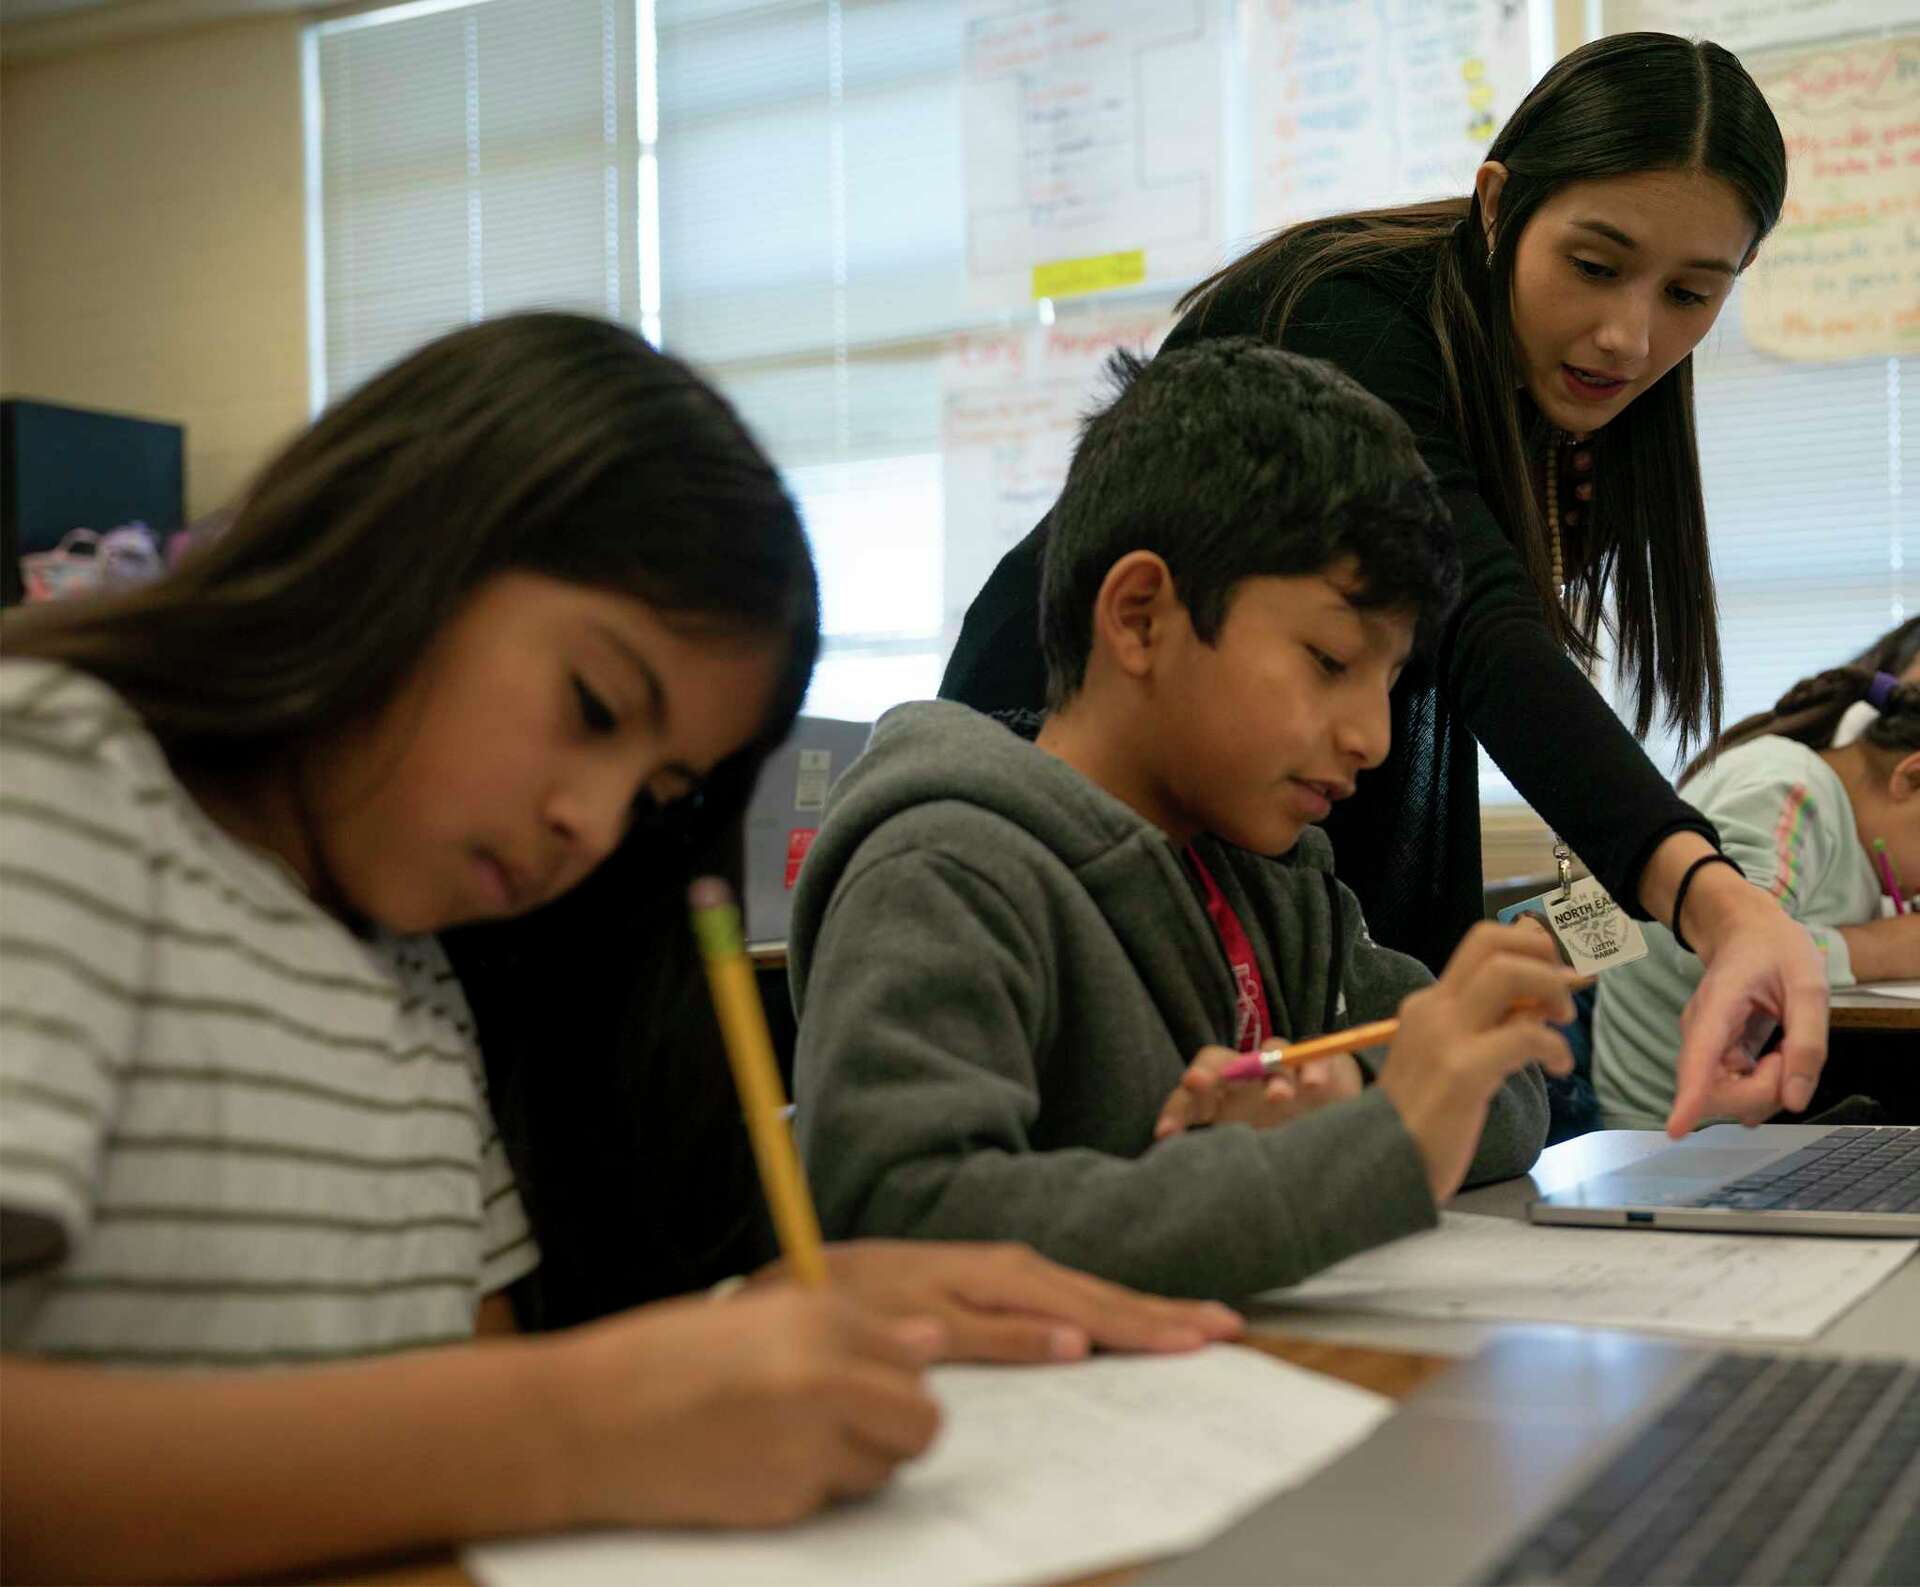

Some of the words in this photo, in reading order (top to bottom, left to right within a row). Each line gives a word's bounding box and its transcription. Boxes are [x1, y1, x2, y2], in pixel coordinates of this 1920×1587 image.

[1554, 903, 1593, 924] NORTH
[1595, 897, 1611, 909] EA
[1592, 939, 1616, 952] LIZETH
[1594, 947, 1619, 960] PARRA
